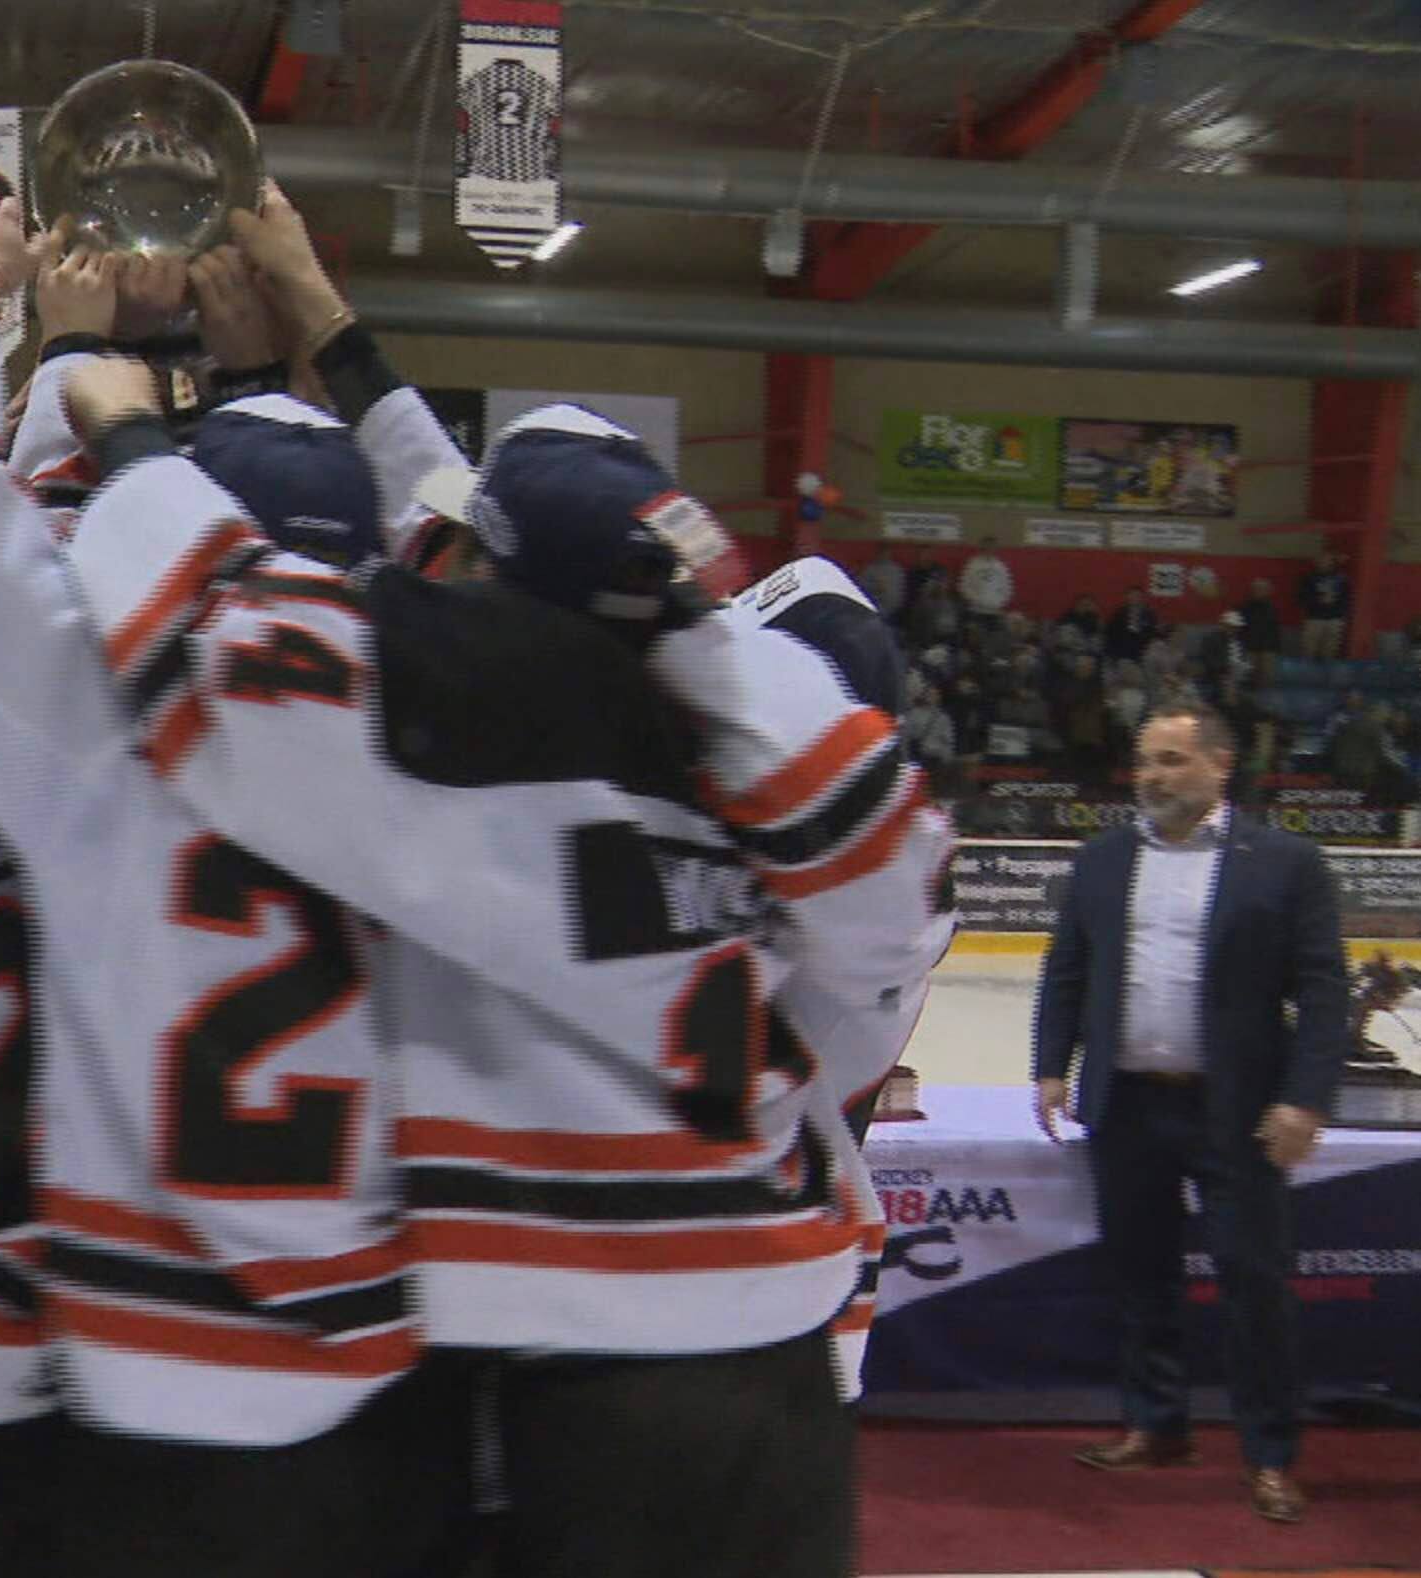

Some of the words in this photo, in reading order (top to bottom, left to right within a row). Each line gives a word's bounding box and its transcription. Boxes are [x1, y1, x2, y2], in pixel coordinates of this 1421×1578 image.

[496, 90, 525, 126] 2
[155, 830, 381, 1200] 2
[879, 1186, 1017, 1226] 18AAA
